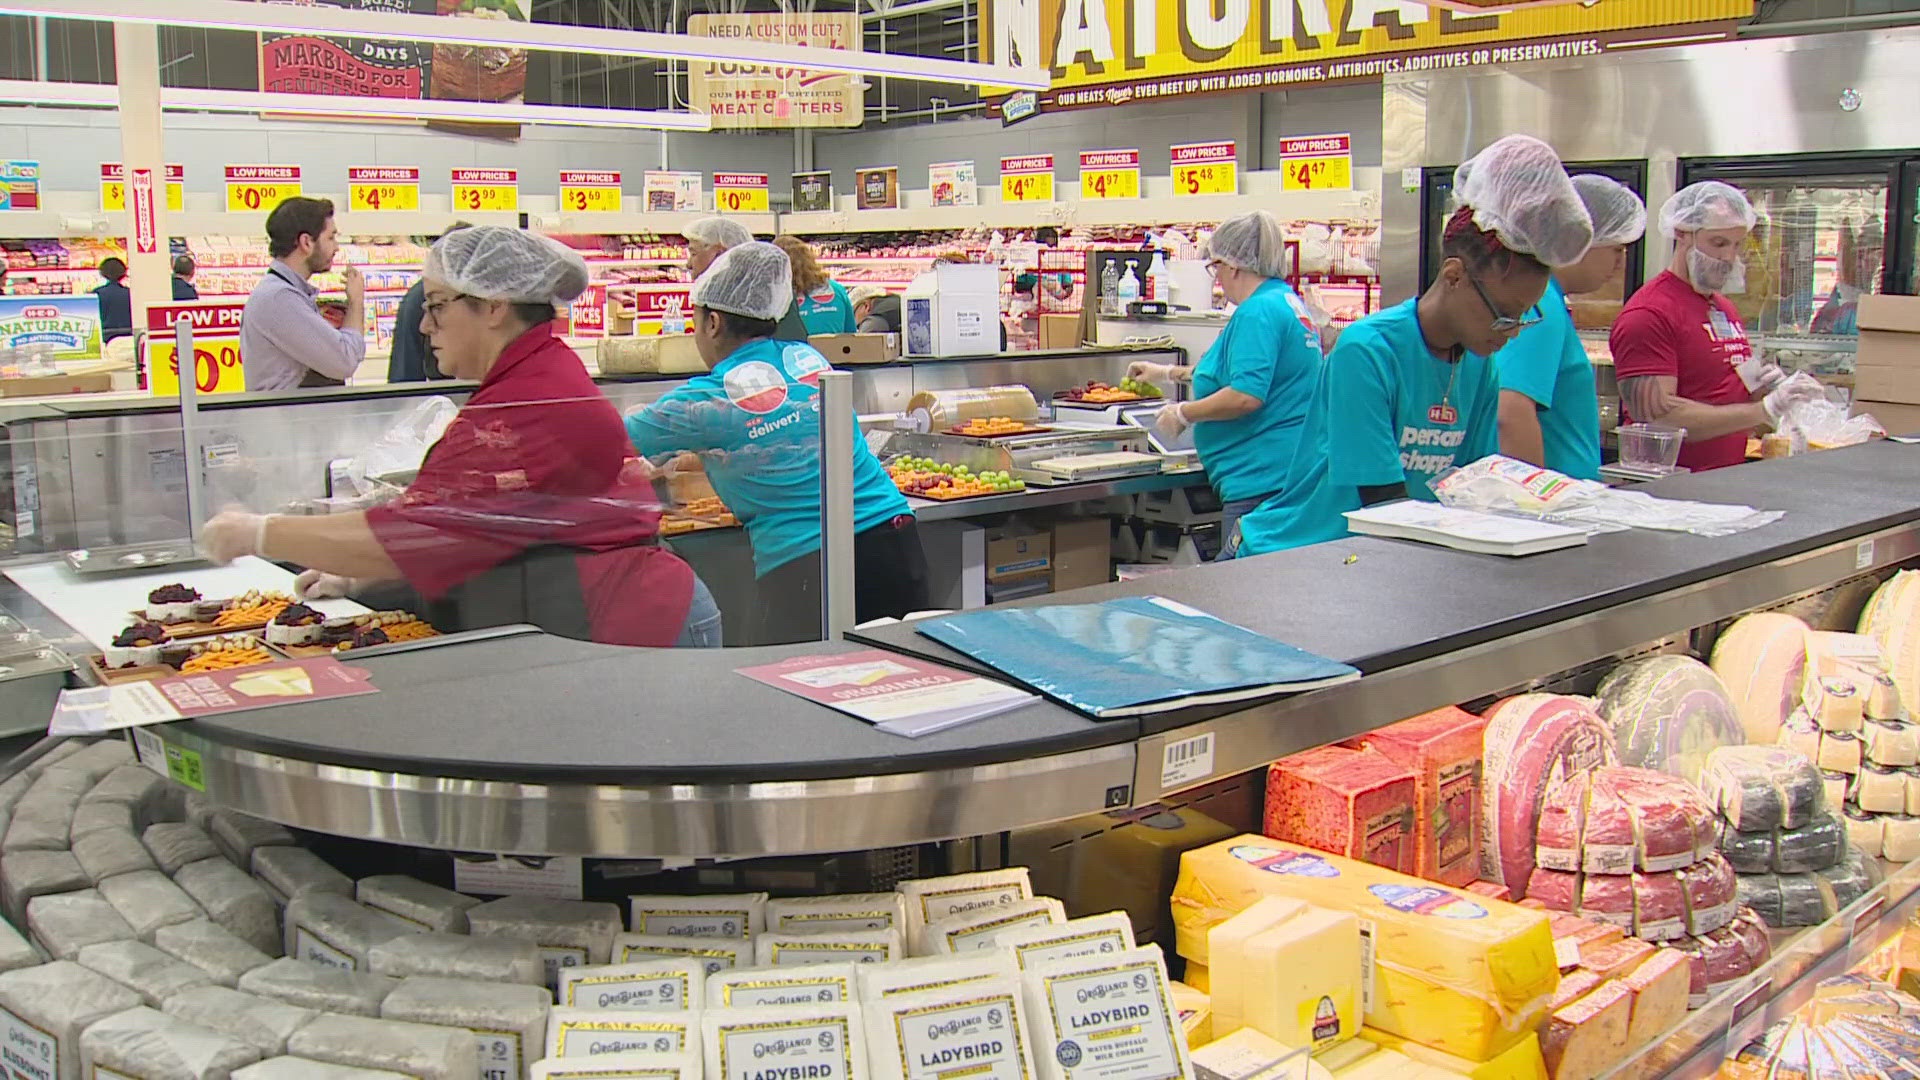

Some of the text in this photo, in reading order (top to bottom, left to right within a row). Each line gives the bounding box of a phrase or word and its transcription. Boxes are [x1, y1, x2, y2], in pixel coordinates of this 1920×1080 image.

[709, 23, 842, 38] NEED A CUSOM CUT?
[363, 42, 408, 61] DAYS
[275, 43, 368, 80] MARBLED
[1058, 38, 1602, 106] OUR MEATS Never EVER MEET UP WITH ADDED HORMONES, ANTIBIOTICS, ADDITIVES OR PRESERVATIVES.
[300, 67, 381, 97] SUPERIOR
[711, 102, 844, 115] MEAT CTERS
[1177, 146, 1228, 159] LOW PRICES
[1287, 139, 1341, 152] LOW PRICES
[1006, 158, 1047, 169] LOW PRICES
[1086, 154, 1131, 164] LOW PRICES
[233, 168, 292, 178] LOW PRICES
[356, 170, 411, 179] LOW PRICES
[459, 171, 509, 180] LOW PRICES
[567, 174, 614, 183] LOW PRICES
[720, 175, 762, 184] LOW PRICES
[574, 290, 596, 306] OW
[650, 294, 685, 309] LOW
[165, 309, 214, 327] LOW
[574, 307, 600, 324] RICES
[0, 319, 84, 334] NATURAL
[748, 410, 801, 440] delivery
[1071, 1004, 1150, 1028] LADYBIRD
[1114, 1038, 1149, 1049] BUFFALO
[920, 1040, 1003, 1067] LADYBIRD
